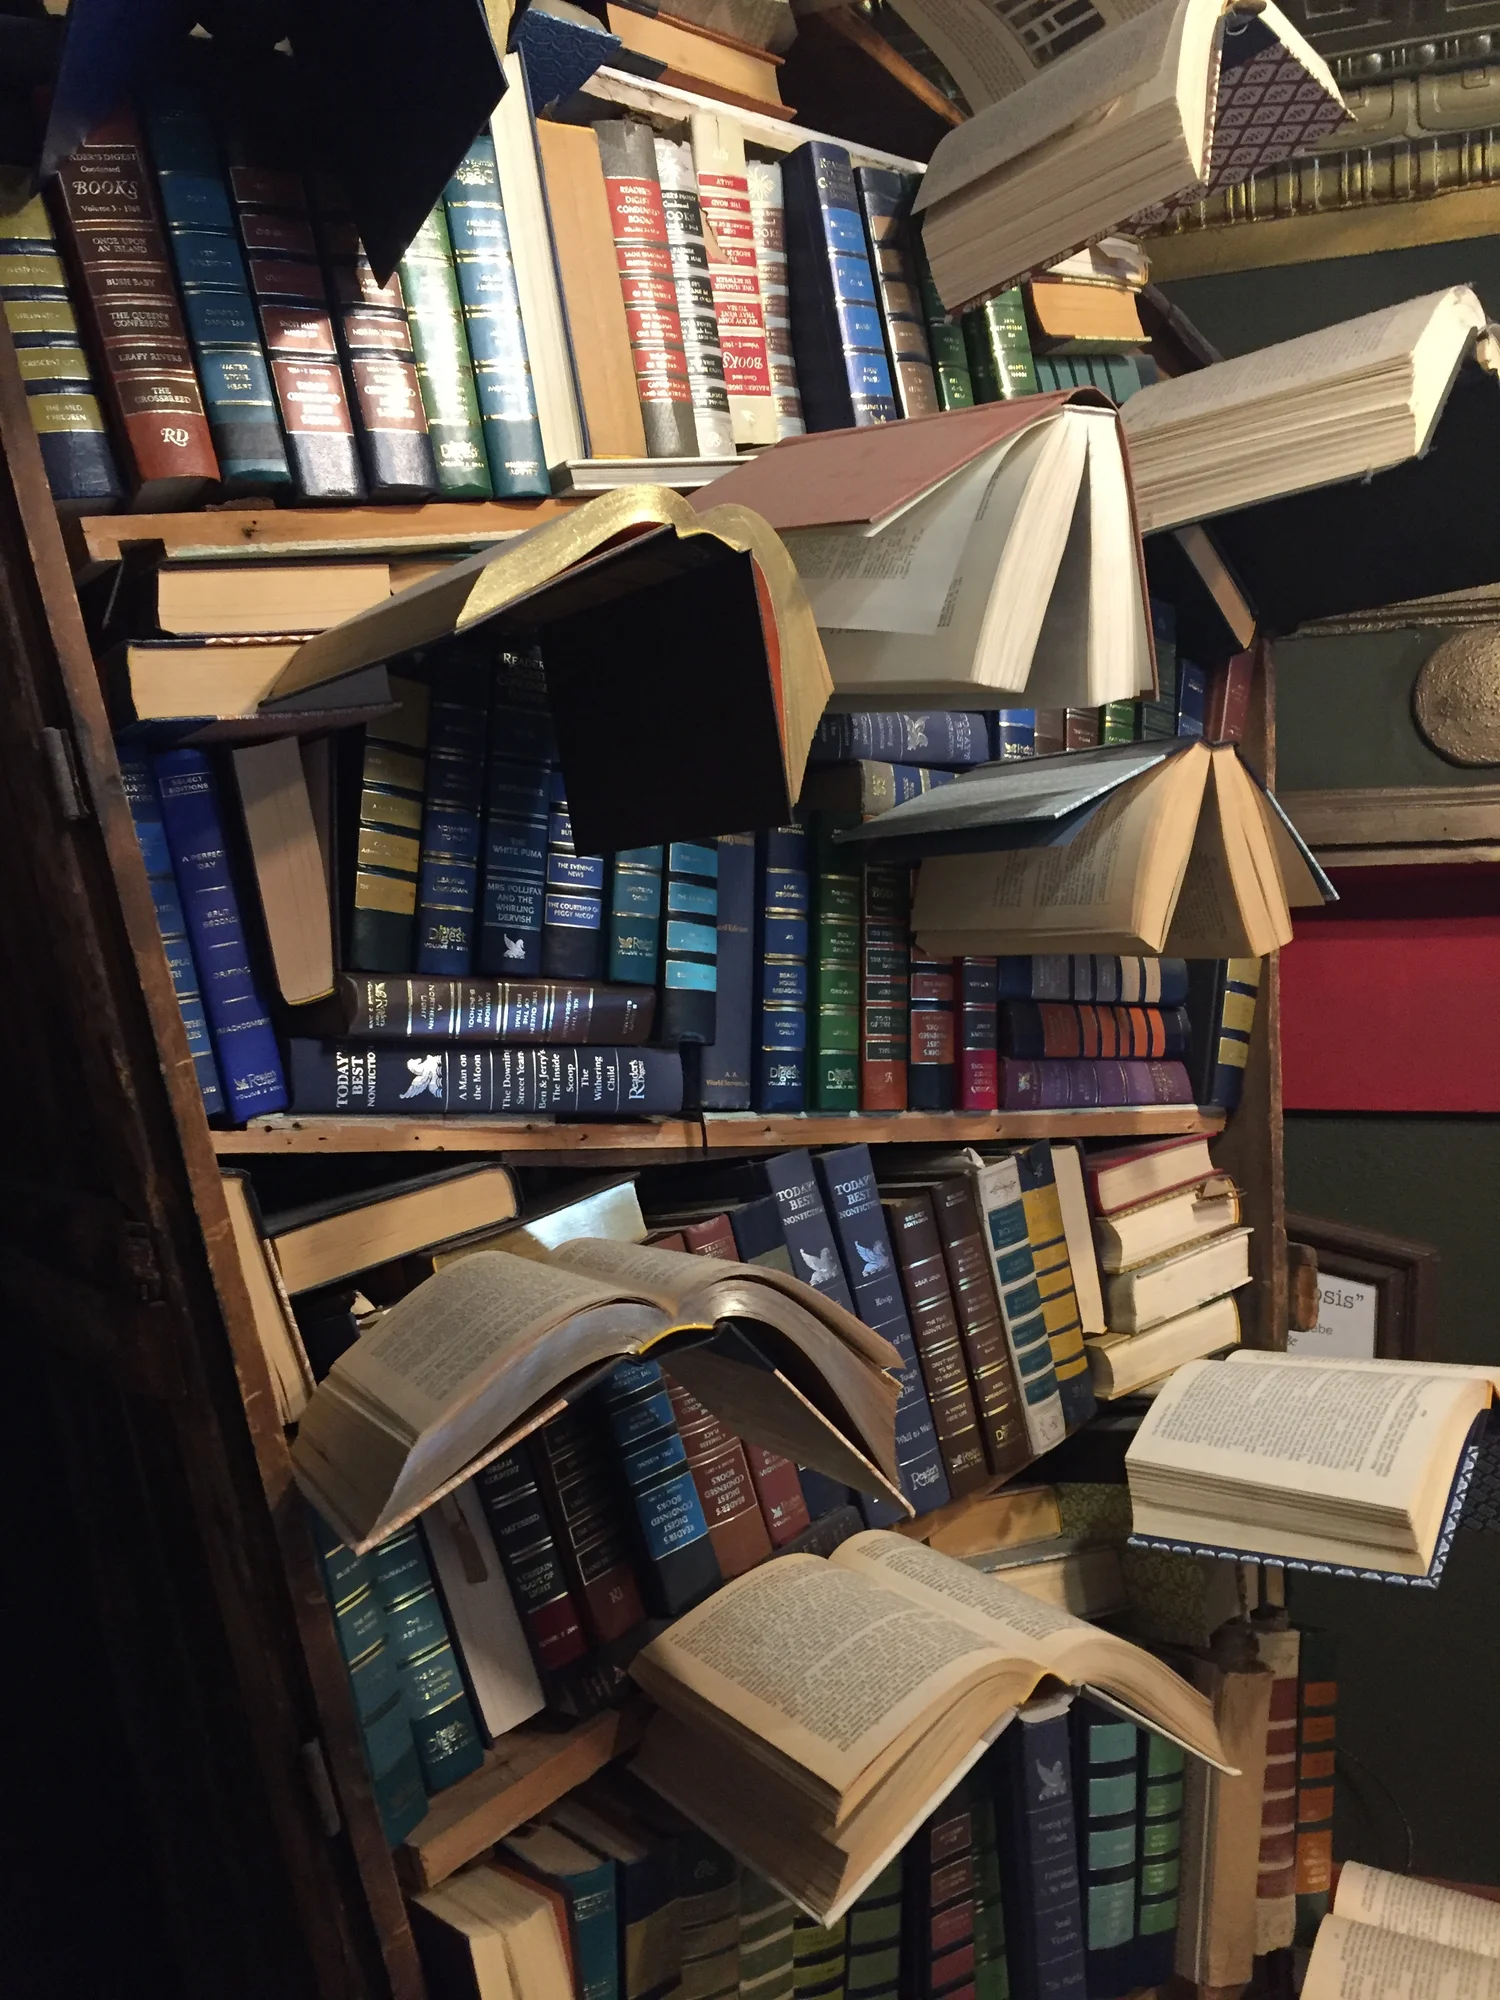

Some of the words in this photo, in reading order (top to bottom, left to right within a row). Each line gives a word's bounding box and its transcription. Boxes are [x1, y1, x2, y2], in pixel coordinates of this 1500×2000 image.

[72, 180, 139, 200] BOOKS
[716, 178, 734, 187] SALLY
[619, 185, 652, 196] READER'S
[81, 204, 112, 213] Volume
[711, 199, 729, 207] ROAD
[627, 214, 654, 225] BOOKS
[92, 236, 120, 246] ONCE
[121, 237, 147, 246] UPON
[97, 245, 112, 254] AN
[114, 245, 148, 254] ISLAND
[726, 249, 751, 257] BROKEN
[106, 278, 131, 287] BUSH
[133, 278, 156, 288] BABY
[714, 283, 740, 291] SUMMER
[109, 311, 130, 320] THE
[131, 312, 170, 323] QUEEN'S
[112, 319, 170, 329] CONFESSION
[718, 315, 735, 324] JOHN
[118, 353, 148, 362] LEAFY
[149, 353, 183, 363] RIVERS
[722, 351, 763, 369] BOOKS
[150, 386, 172, 396] THE
[134, 395, 192, 405] CROSSBREED
[160, 427, 190, 447] RD
[502, 652, 546, 670] READER
[954, 720, 964, 750] BEST
[492, 844, 519, 856] WHITE
[520, 848, 543, 859] PUMA
[197, 860, 217, 870] DAY
[557, 861, 569, 870] THE
[569, 862, 595, 873] EVENING
[567, 870, 585, 879] NEWS
[507, 885, 543, 896] POLLIFAX
[497, 893, 516, 902] AND
[517, 895, 534, 905] THE
[206, 908, 229, 919] SPLIT
[495, 903, 535, 915] WHIRLING
[553, 908, 574, 919] PEGGY
[559, 902, 592, 912] COURTSHIP
[497, 912, 532, 924] DERVISH
[213, 965, 251, 980] DRIFTING
[477, 995, 484, 1008] AT
[522, 997, 531, 1009] OF
[531, 990, 539, 1006] THE
[420, 994, 428, 1019] LIGHT
[427, 984, 436, 1030] NORTHERN
[436, 1003, 443, 1012] A
[467, 988, 477, 1029] B-SCHOOL
[483, 991, 492, 1028] MURDER
[476, 1009, 484, 1024] THE
[514, 1009, 523, 1029] TIME
[522, 1010, 530, 1025] THE
[529, 1006, 538, 1035] QUEEN
[459, 1053, 468, 1068] on
[551, 1053, 561, 1081] Inside
[351, 1055, 364, 1095] BEST
[472, 1054, 482, 1083] Moon
[336, 1046, 349, 1108] TODAY'
[366, 1046, 377, 1107] NONFICTIO
[458, 1070, 468, 1092] Man
[538, 1079, 547, 1089] &
[565, 1063, 576, 1092] Scoop
[580, 1068, 590, 1087] The
[593, 1055, 604, 1101] Withering
[606, 1065, 616, 1092] Child
[459, 1092, 468, 1101] A
[472, 1084, 482, 1101] the
[516, 1078, 526, 1105] Street
[538, 1089, 547, 1109] Ben
[551, 1082, 561, 1102] The
[501, 1089, 511, 1110] The
[775, 1179, 815, 1202] TODAY'
[833, 1172, 876, 1196] TODAY'
[788, 1193, 815, 1211] BEST
[846, 1187, 873, 1206] BEST
[903, 1210, 926, 1222] SELECT
[903, 1217, 929, 1230] EDITIONS
[874, 1294, 894, 1307] Koop
[899, 1370, 918, 1383] Tough
[904, 1384, 916, 1395] Die
[703, 1427, 721, 1440] PLACE
[699, 1435, 723, 1450] TIMELESS
[710, 1467, 737, 1486] BOOKS
[703, 1473, 746, 1499] CONDENSED
[655, 1493, 683, 1513] BOOKS
[716, 1487, 742, 1506] DIGEST
[650, 1499, 694, 1528] CONDENSED
[714, 1495, 747, 1517] READER'S
[663, 1514, 690, 1534] DIGEST
[662, 1523, 696, 1546] READER'S
